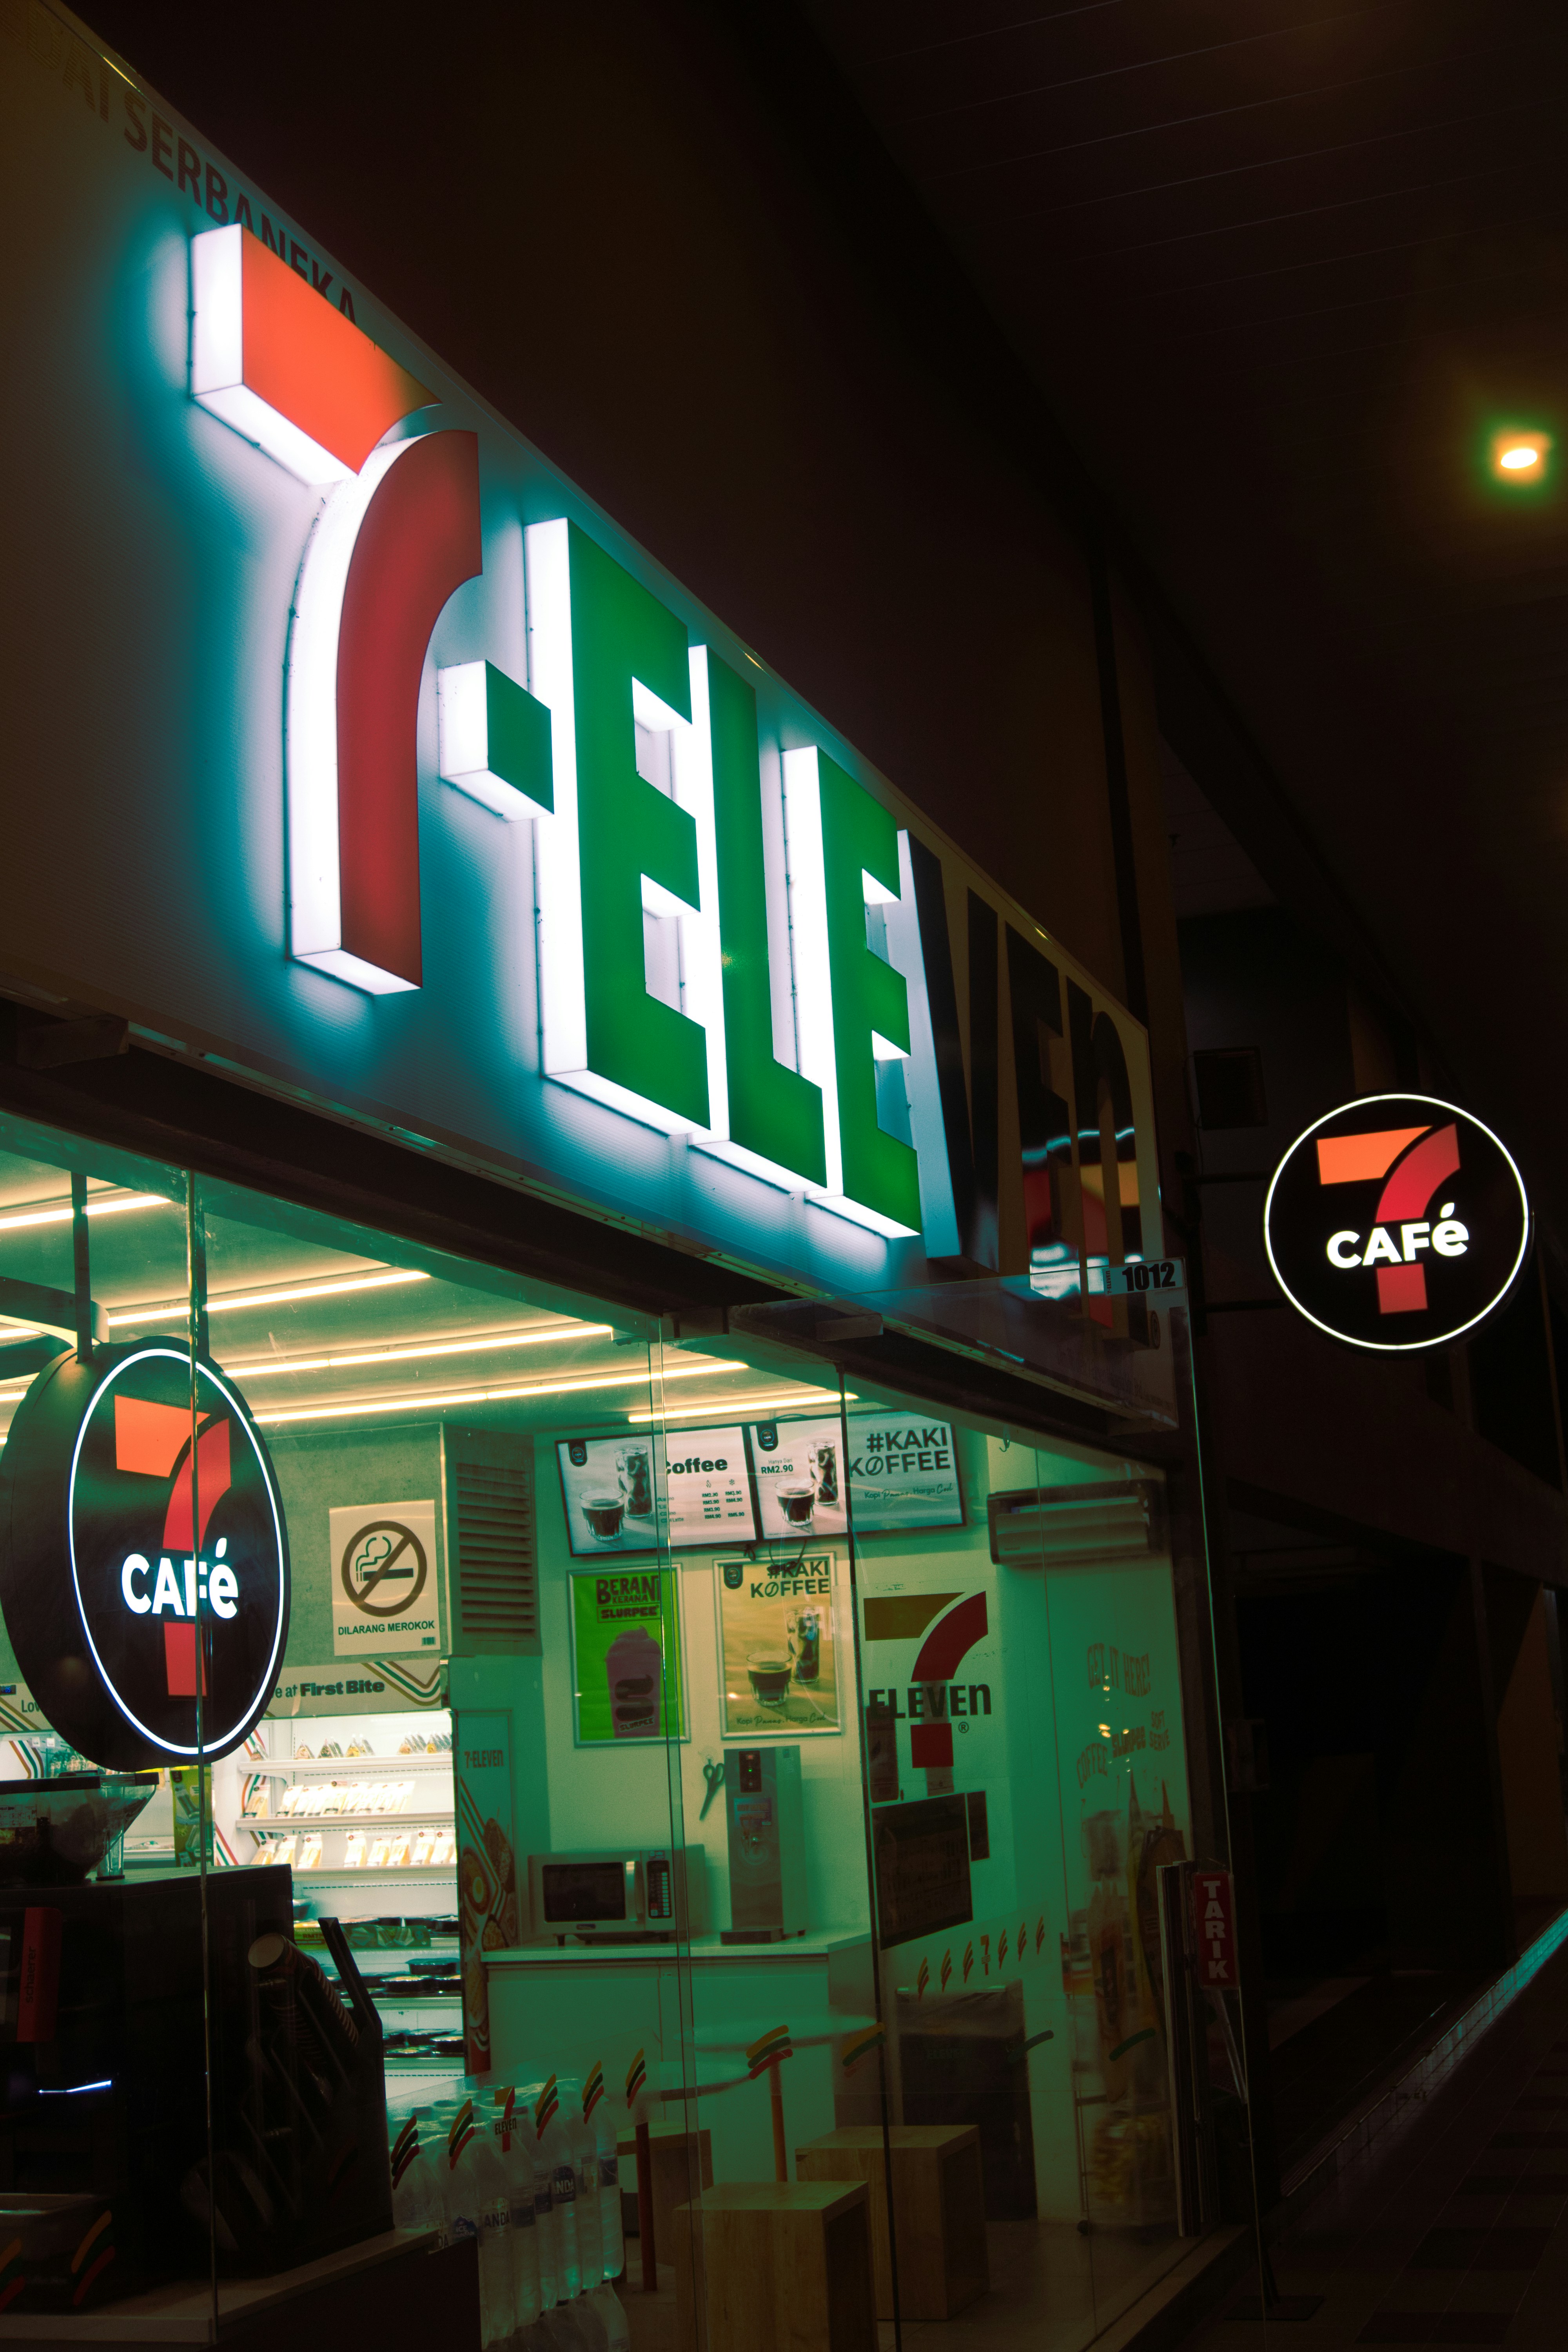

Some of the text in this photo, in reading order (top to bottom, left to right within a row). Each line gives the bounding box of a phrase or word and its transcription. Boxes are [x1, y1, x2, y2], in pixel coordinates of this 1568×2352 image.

[1122, 1262, 1176, 1292] 1012
[866, 1427, 948, 1453] #KAKI
[761, 1465, 793, 1475] RM2.90
[864, 1492, 880, 1500] Kopi
[338, 1620, 435, 1635] DILARANG MEROKOK
[1087, 1642, 1151, 1697] GET IT HERE!
[285, 1684, 298, 1698] at
[300, 1681, 344, 1697] First
[345, 1680, 385, 1694] Bite
[21, 1699, 40, 1713] Lov
[1151, 1710, 1165, 1730] SOFT
[1149, 1728, 1171, 1752] SERVE
[1076, 1742, 1108, 1789] COFFEE
[1202, 1880, 1229, 1979] TARIK
[24, 1945, 36, 2003] schaerer
